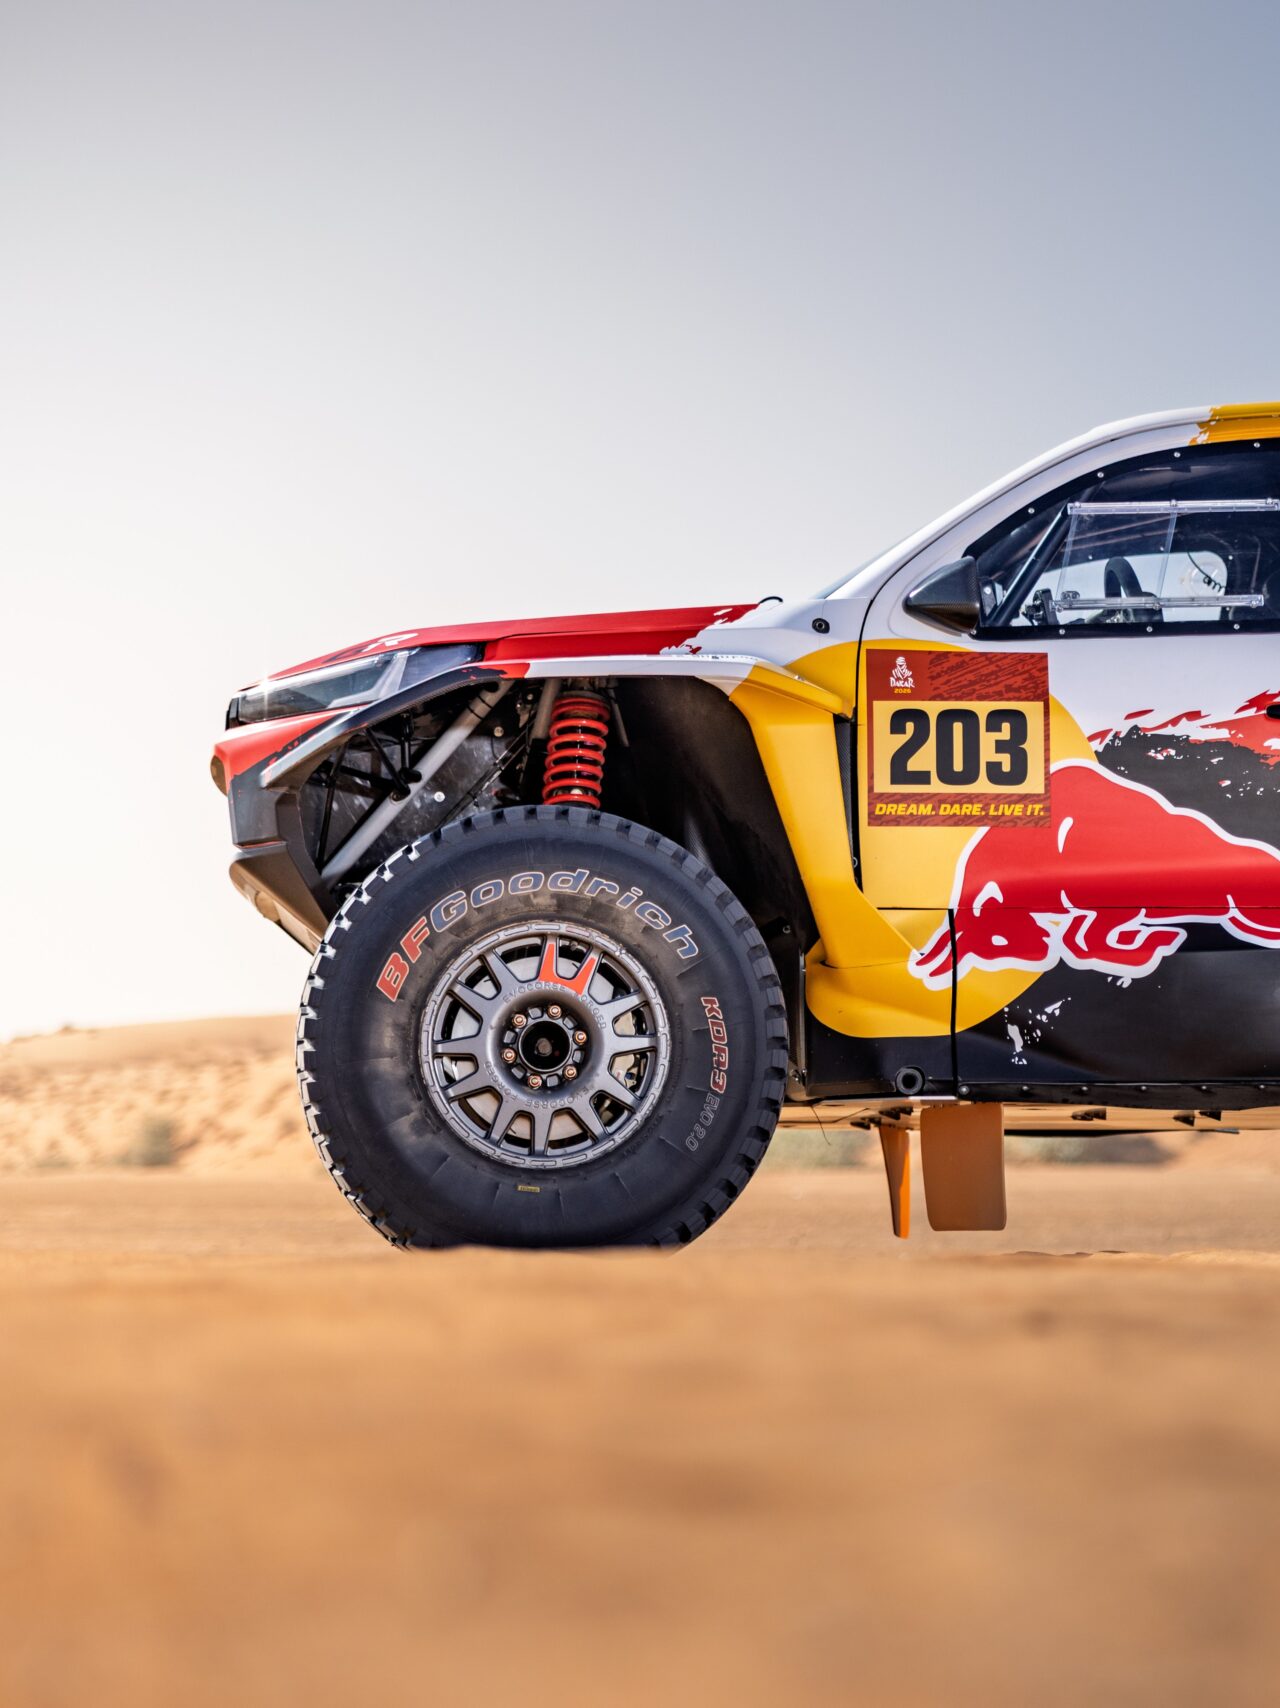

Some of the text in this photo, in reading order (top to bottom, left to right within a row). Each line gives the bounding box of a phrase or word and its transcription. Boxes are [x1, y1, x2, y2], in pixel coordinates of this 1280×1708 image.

[890, 708, 1028, 787] 203
[875, 803, 1045, 816] DREAM. DARE. LIVE IT.
[376, 869, 699, 1002] BFGoodrich
[700, 996, 729, 1094] KDR3
